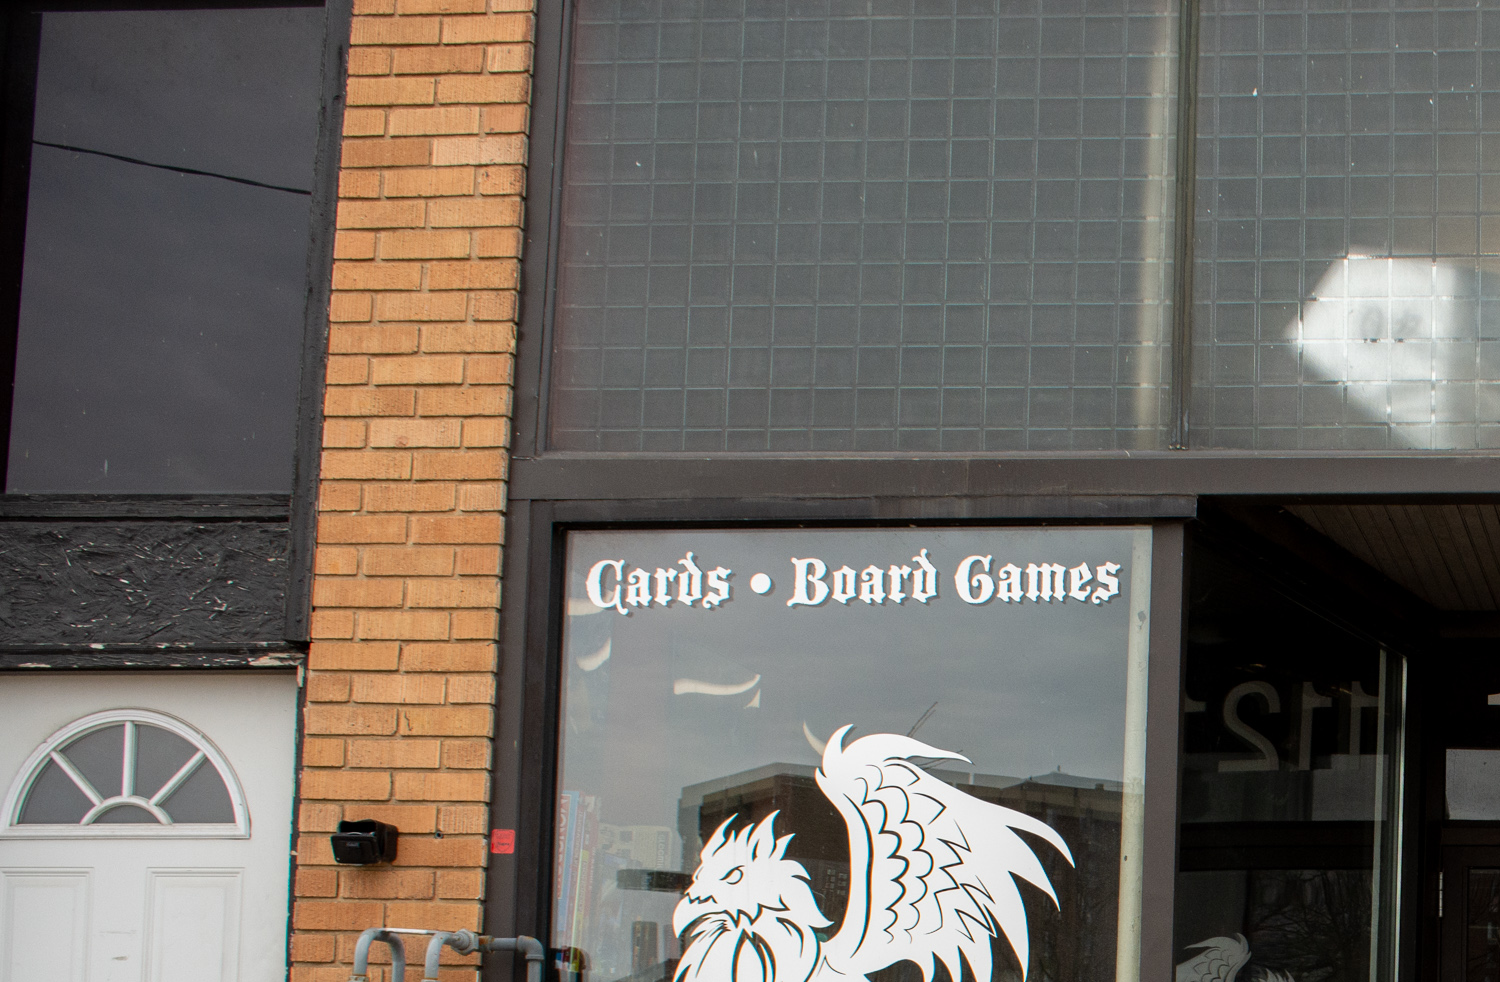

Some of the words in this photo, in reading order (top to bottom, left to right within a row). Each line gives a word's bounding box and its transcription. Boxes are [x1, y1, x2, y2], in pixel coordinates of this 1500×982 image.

[585, 550, 734, 618] Cards
[786, 547, 940, 608] Board
[954, 554, 1122, 606] Games
